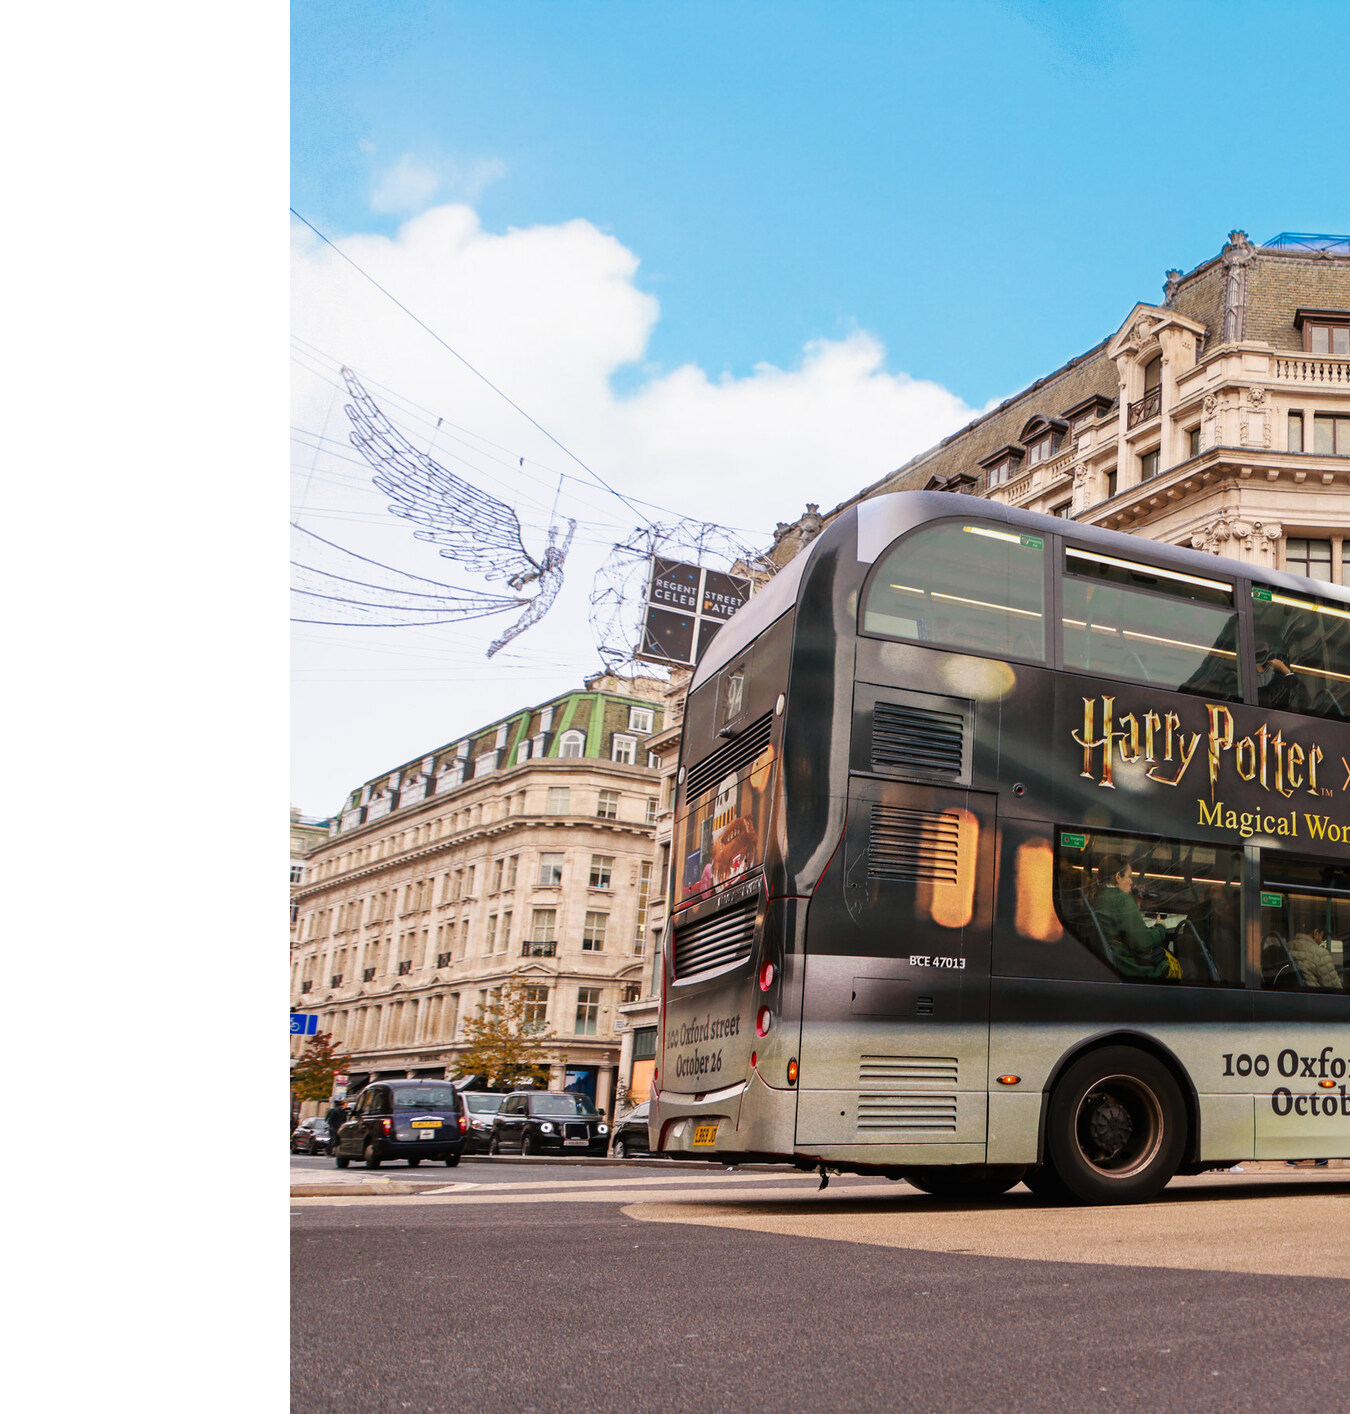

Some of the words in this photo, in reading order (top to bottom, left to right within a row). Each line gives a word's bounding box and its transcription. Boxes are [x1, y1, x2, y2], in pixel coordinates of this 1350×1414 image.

[656, 579, 697, 595] REGENT
[705, 591, 742, 606] STREET
[1072, 695, 1201, 789] Harry
[1205, 703, 1324, 801] Potter
[1197, 799, 1298, 837] Magical
[910, 955, 931, 967] BCE
[932, 956, 966, 969] 47013
[680, 1013, 710, 1046] Oxford
[711, 1014, 741, 1040] street
[676, 1048, 710, 1078] October
[711, 1049, 722, 1072] 26
[1222, 1053, 1270, 1077] 100
